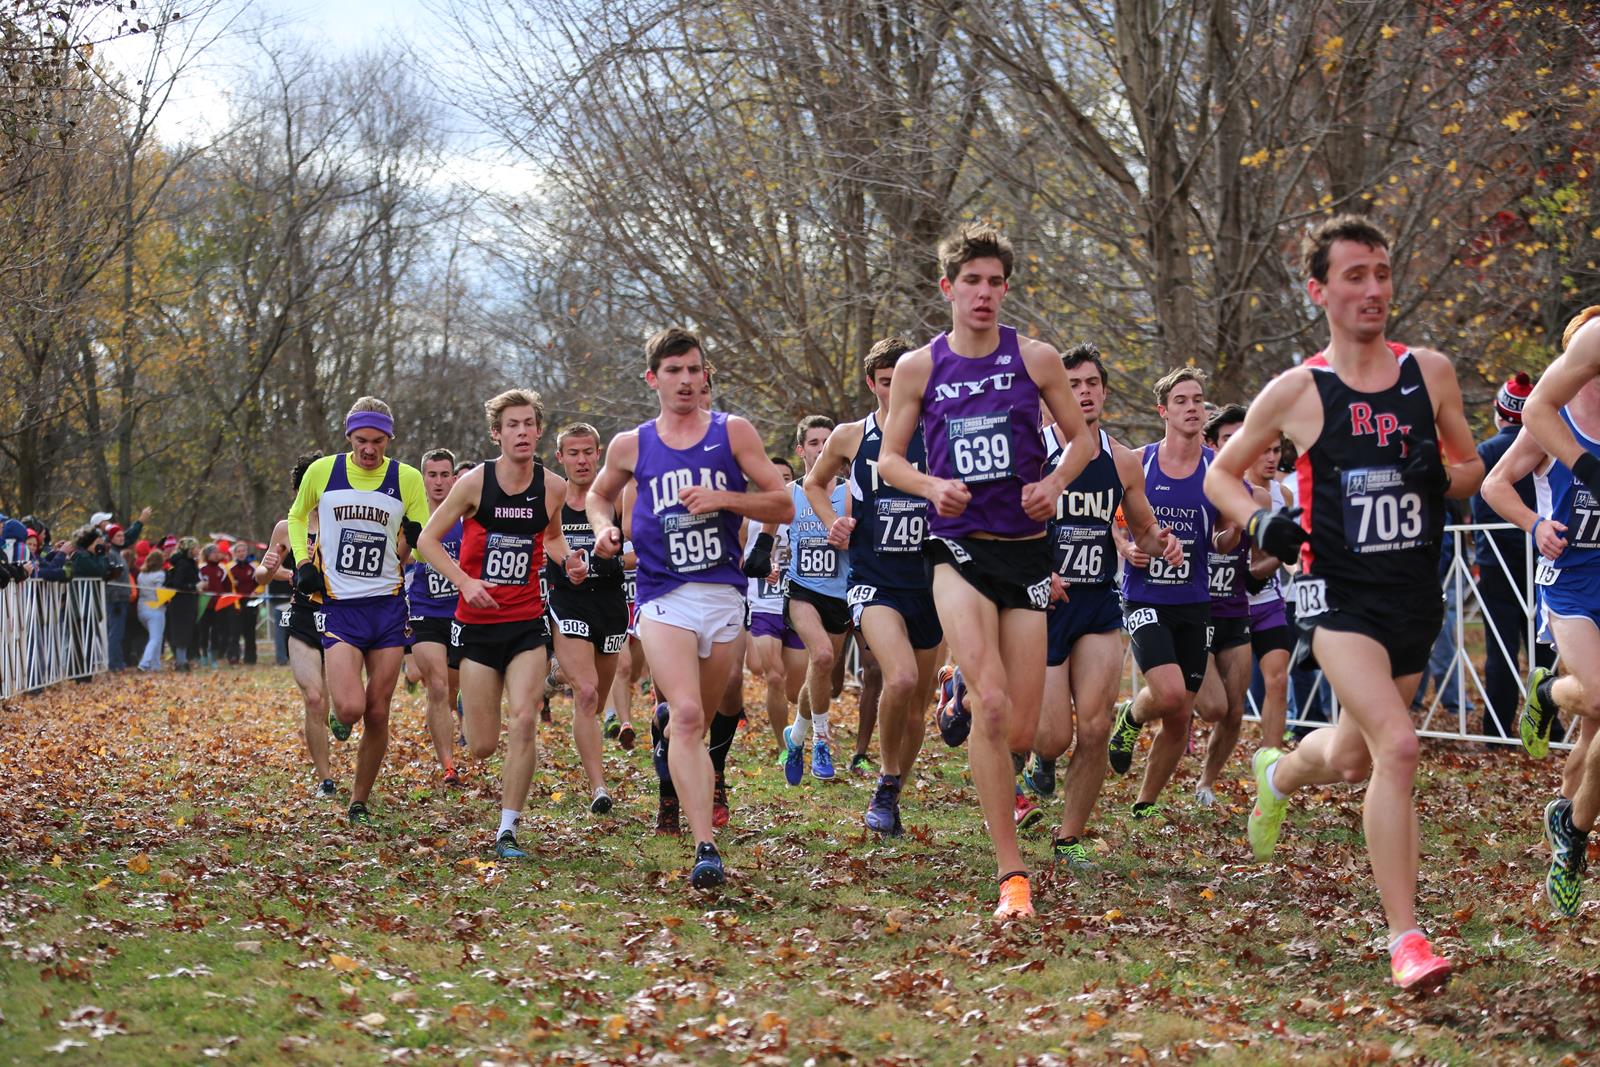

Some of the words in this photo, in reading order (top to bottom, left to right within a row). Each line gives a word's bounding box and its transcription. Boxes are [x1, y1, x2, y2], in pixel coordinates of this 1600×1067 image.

[935, 373, 1016, 402] NYU
[954, 433, 1010, 475] 639
[649, 468, 728, 516] LORAS
[1056, 488, 1114, 523] TCNJ
[333, 505, 390, 527] WILLIAMS
[494, 507, 534, 519] RHODES
[1152, 506, 1198, 519] MOUNT
[1351, 492, 1422, 543] 703
[1575, 508, 1600, 541] 77
[879, 516, 924, 545] 749
[341, 544, 381, 572] 813
[669, 527, 722, 566] 595
[800, 549, 836, 572] 580
[1059, 544, 1103, 576] 746
[486, 549, 529, 579] 698
[1149, 553, 1191, 579] 625
[853, 586, 873, 601] 49
[1299, 584, 1321, 613] 03
[656, 604, 666, 616] L
[1129, 609, 1154, 631] 625
[563, 620, 588, 635] 503
